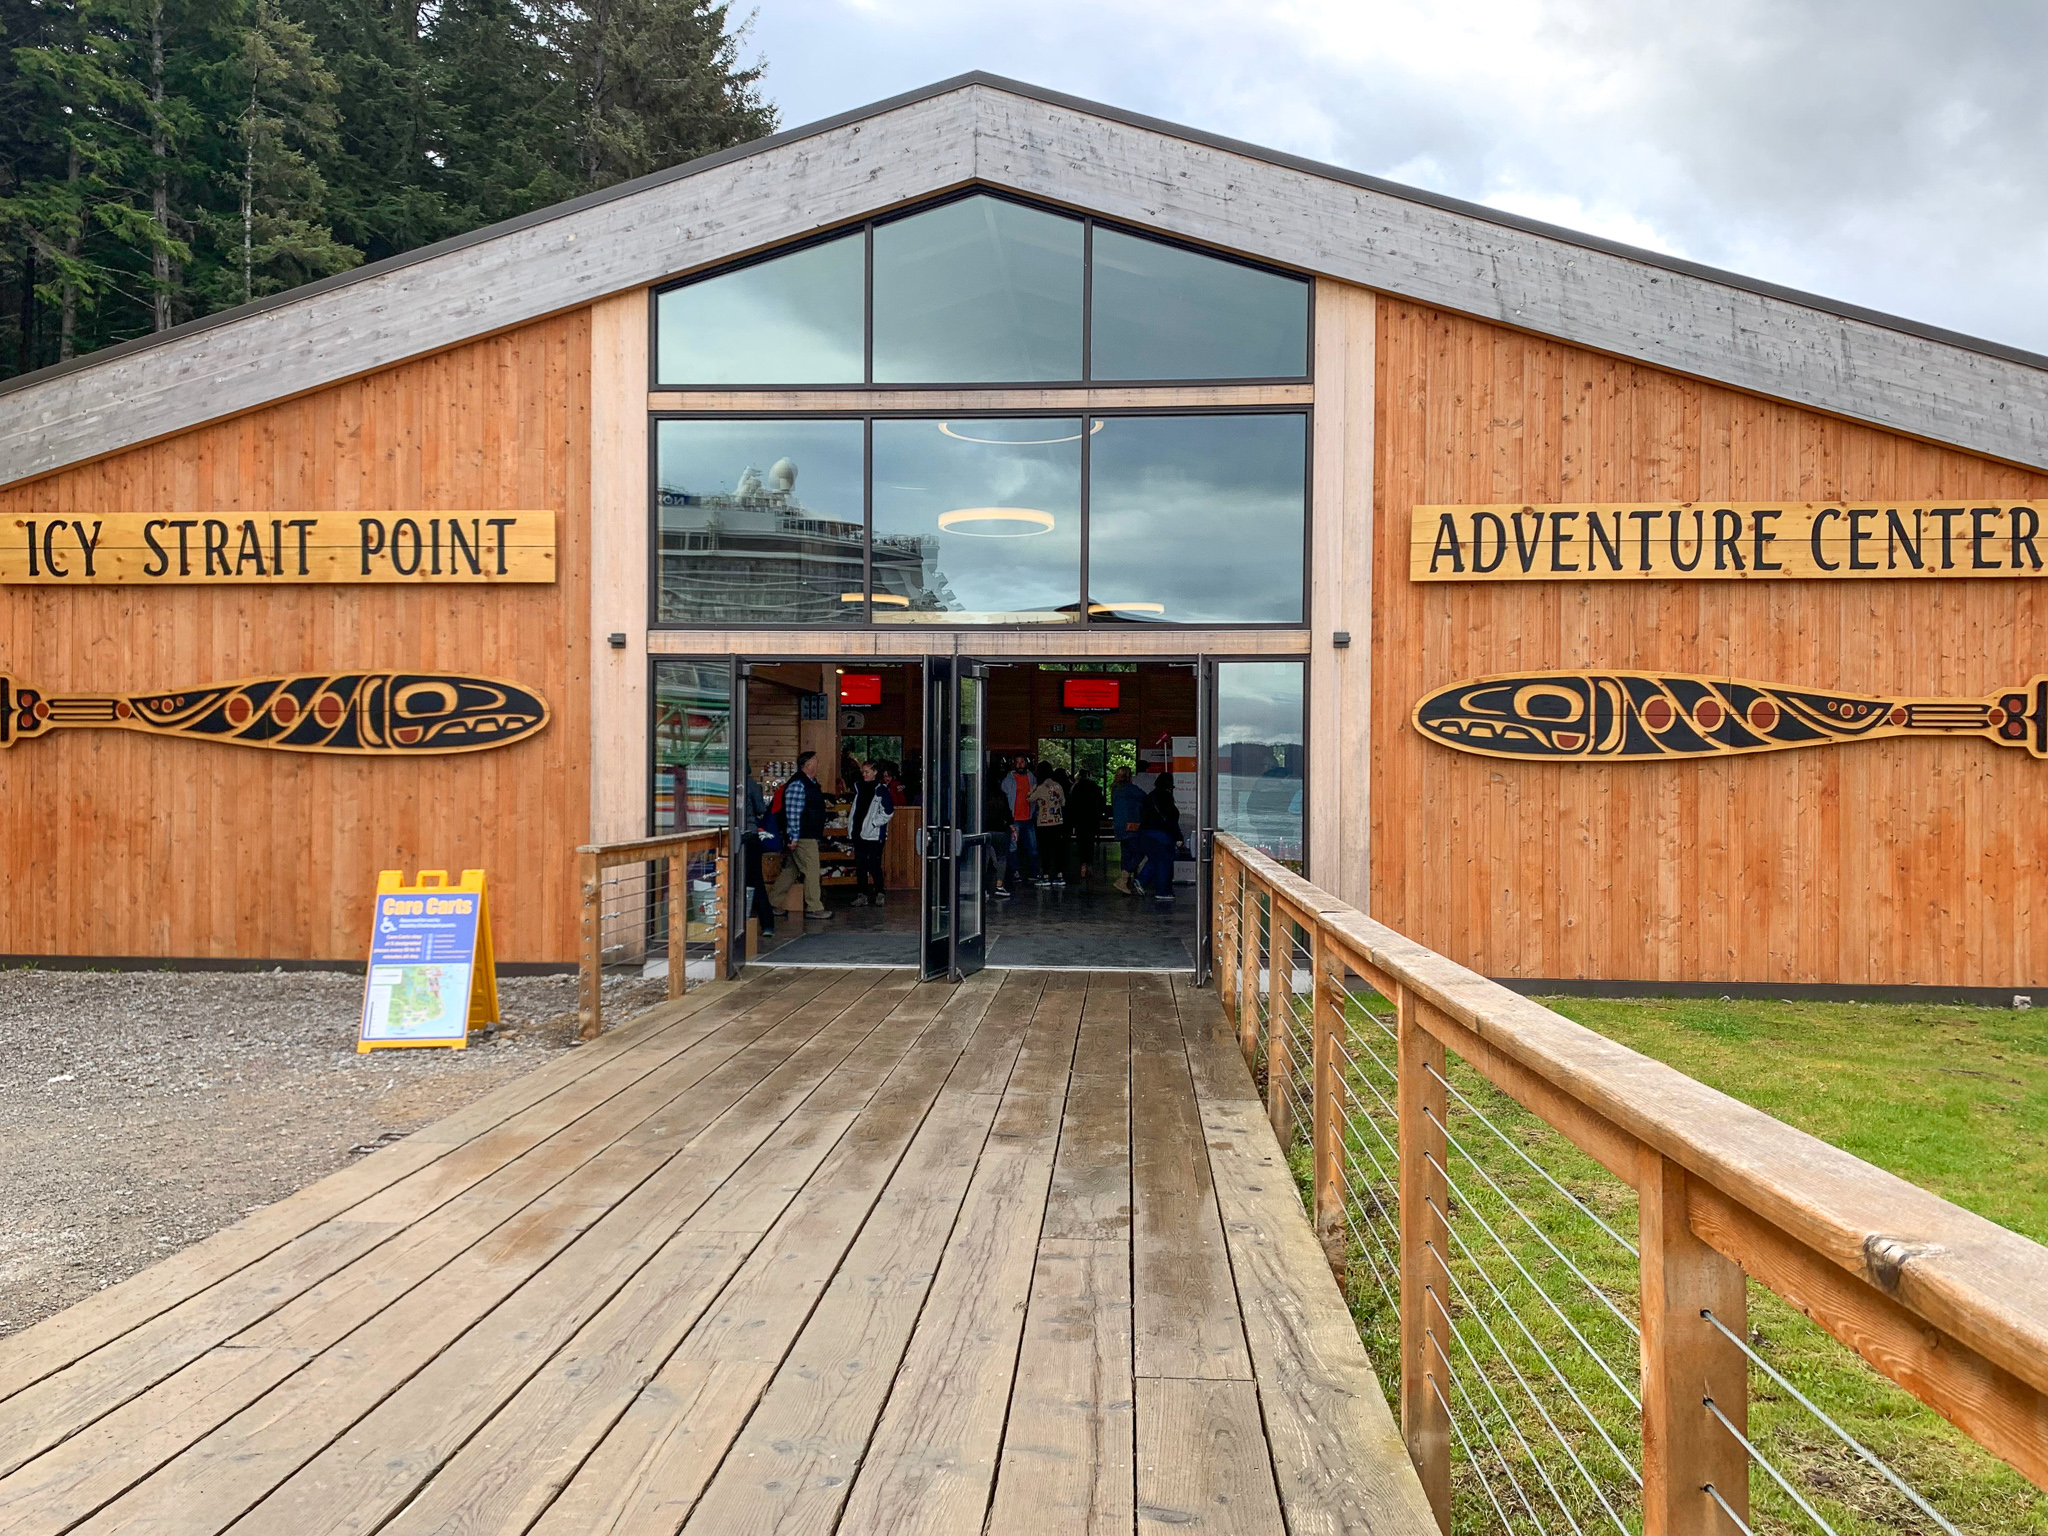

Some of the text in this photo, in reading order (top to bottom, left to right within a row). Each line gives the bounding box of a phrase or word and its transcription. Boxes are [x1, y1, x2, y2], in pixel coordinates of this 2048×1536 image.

[25, 518, 518, 577] ICY STRAIT POINT
[1429, 507, 2044, 573] ADVENTURE CENTER
[846, 715, 856, 728] 2
[383, 897, 472, 915] Care Carts
